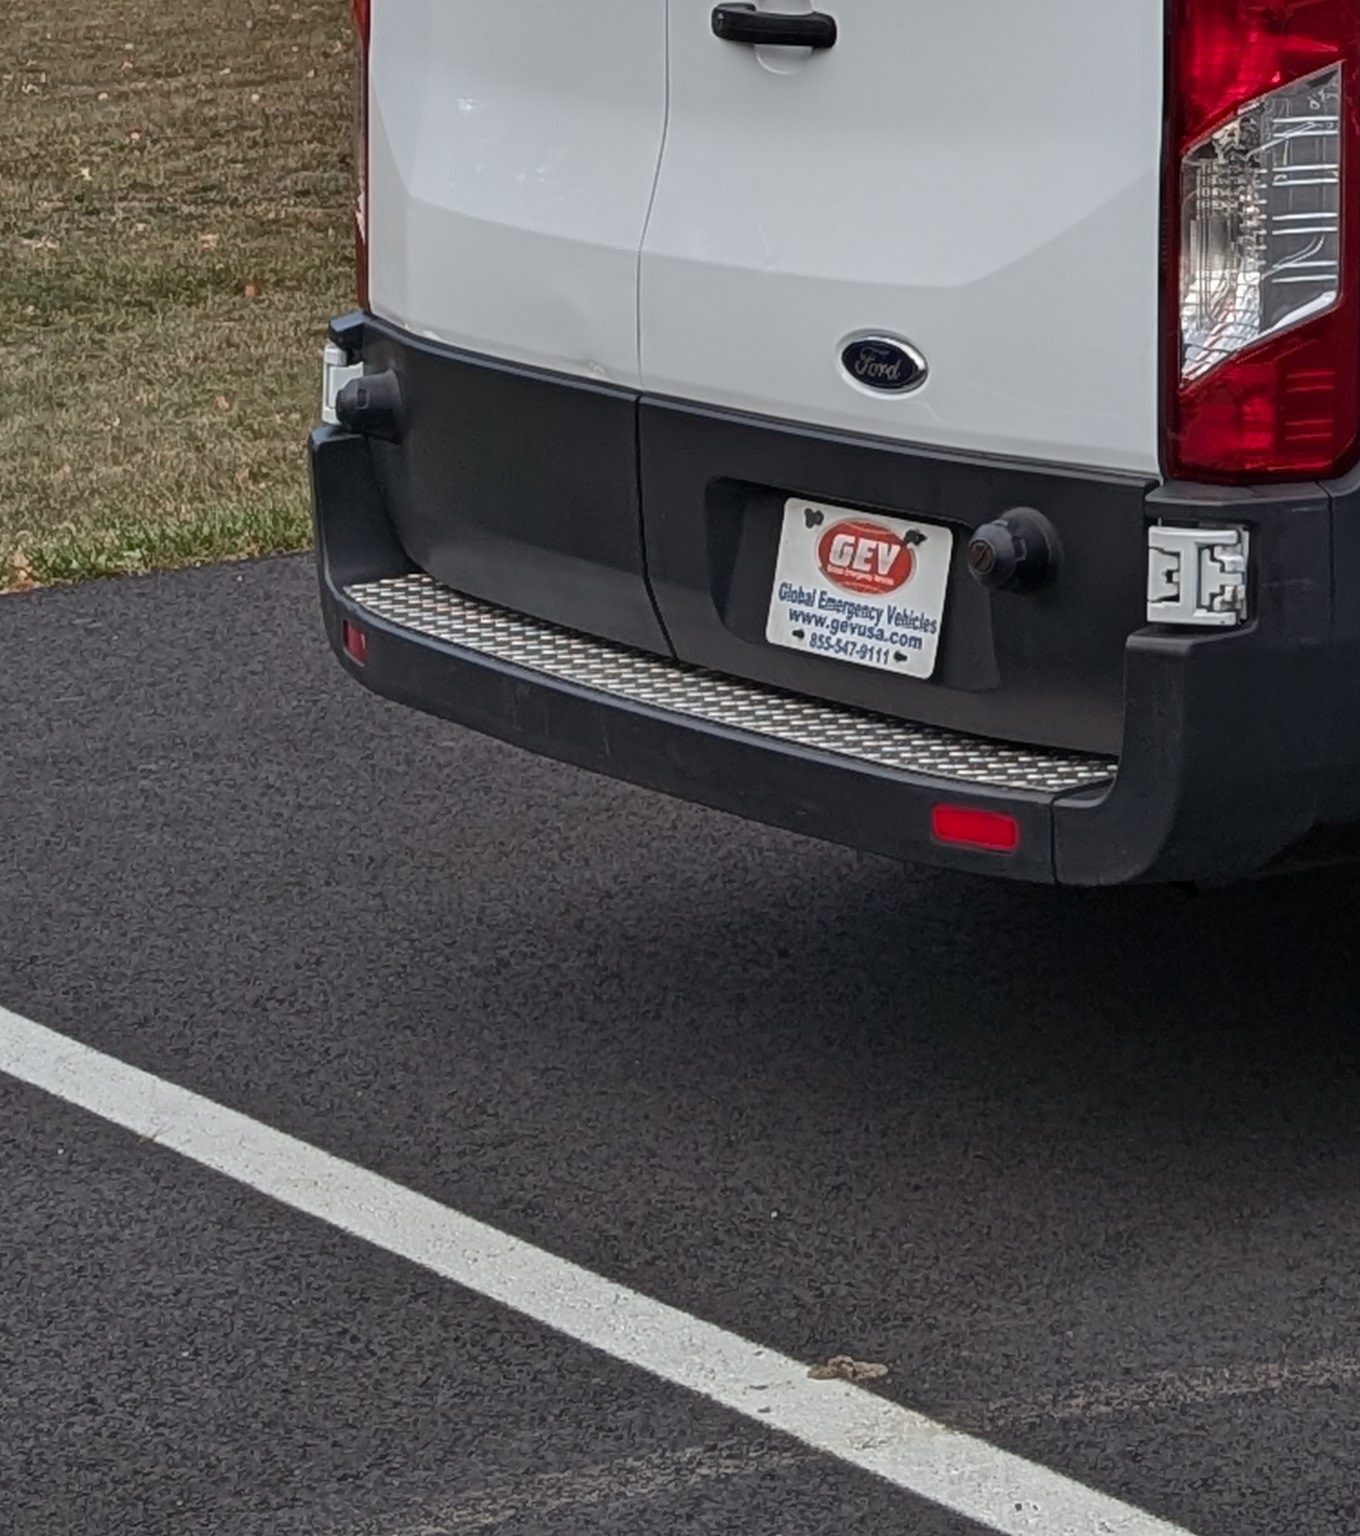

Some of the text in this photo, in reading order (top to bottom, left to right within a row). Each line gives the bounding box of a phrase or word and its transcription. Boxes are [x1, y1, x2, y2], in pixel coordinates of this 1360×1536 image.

[854, 346, 902, 381] Ford
[828, 533, 901, 576] GEV
[778, 581, 938, 635] Global Emergency Vehicles
[788, 608, 923, 651] www.gevusa.com
[808, 632, 890, 665] 855-547-9111
